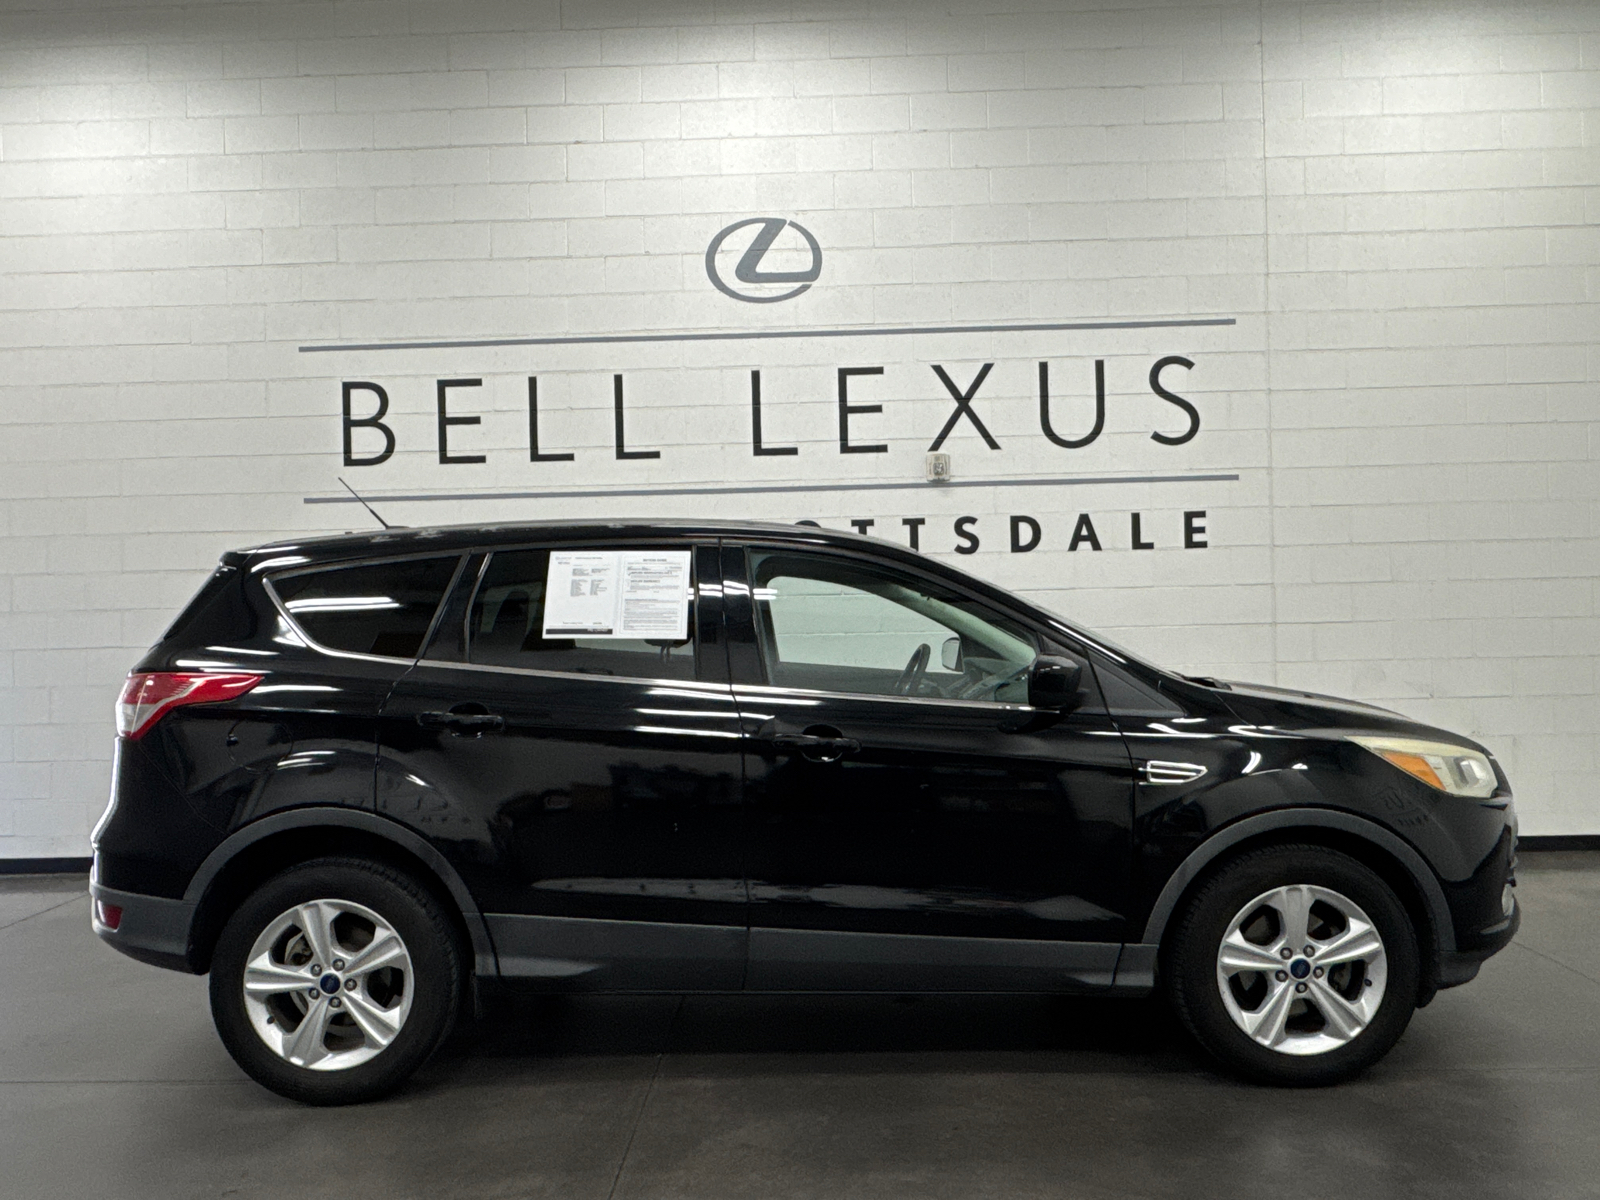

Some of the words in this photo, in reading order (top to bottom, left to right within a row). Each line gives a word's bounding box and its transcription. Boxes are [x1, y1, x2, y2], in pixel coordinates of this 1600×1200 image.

[341, 374, 661, 467] BELL
[751, 355, 1200, 456] LEXUS
[794, 510, 1208, 555] TTSDALE
